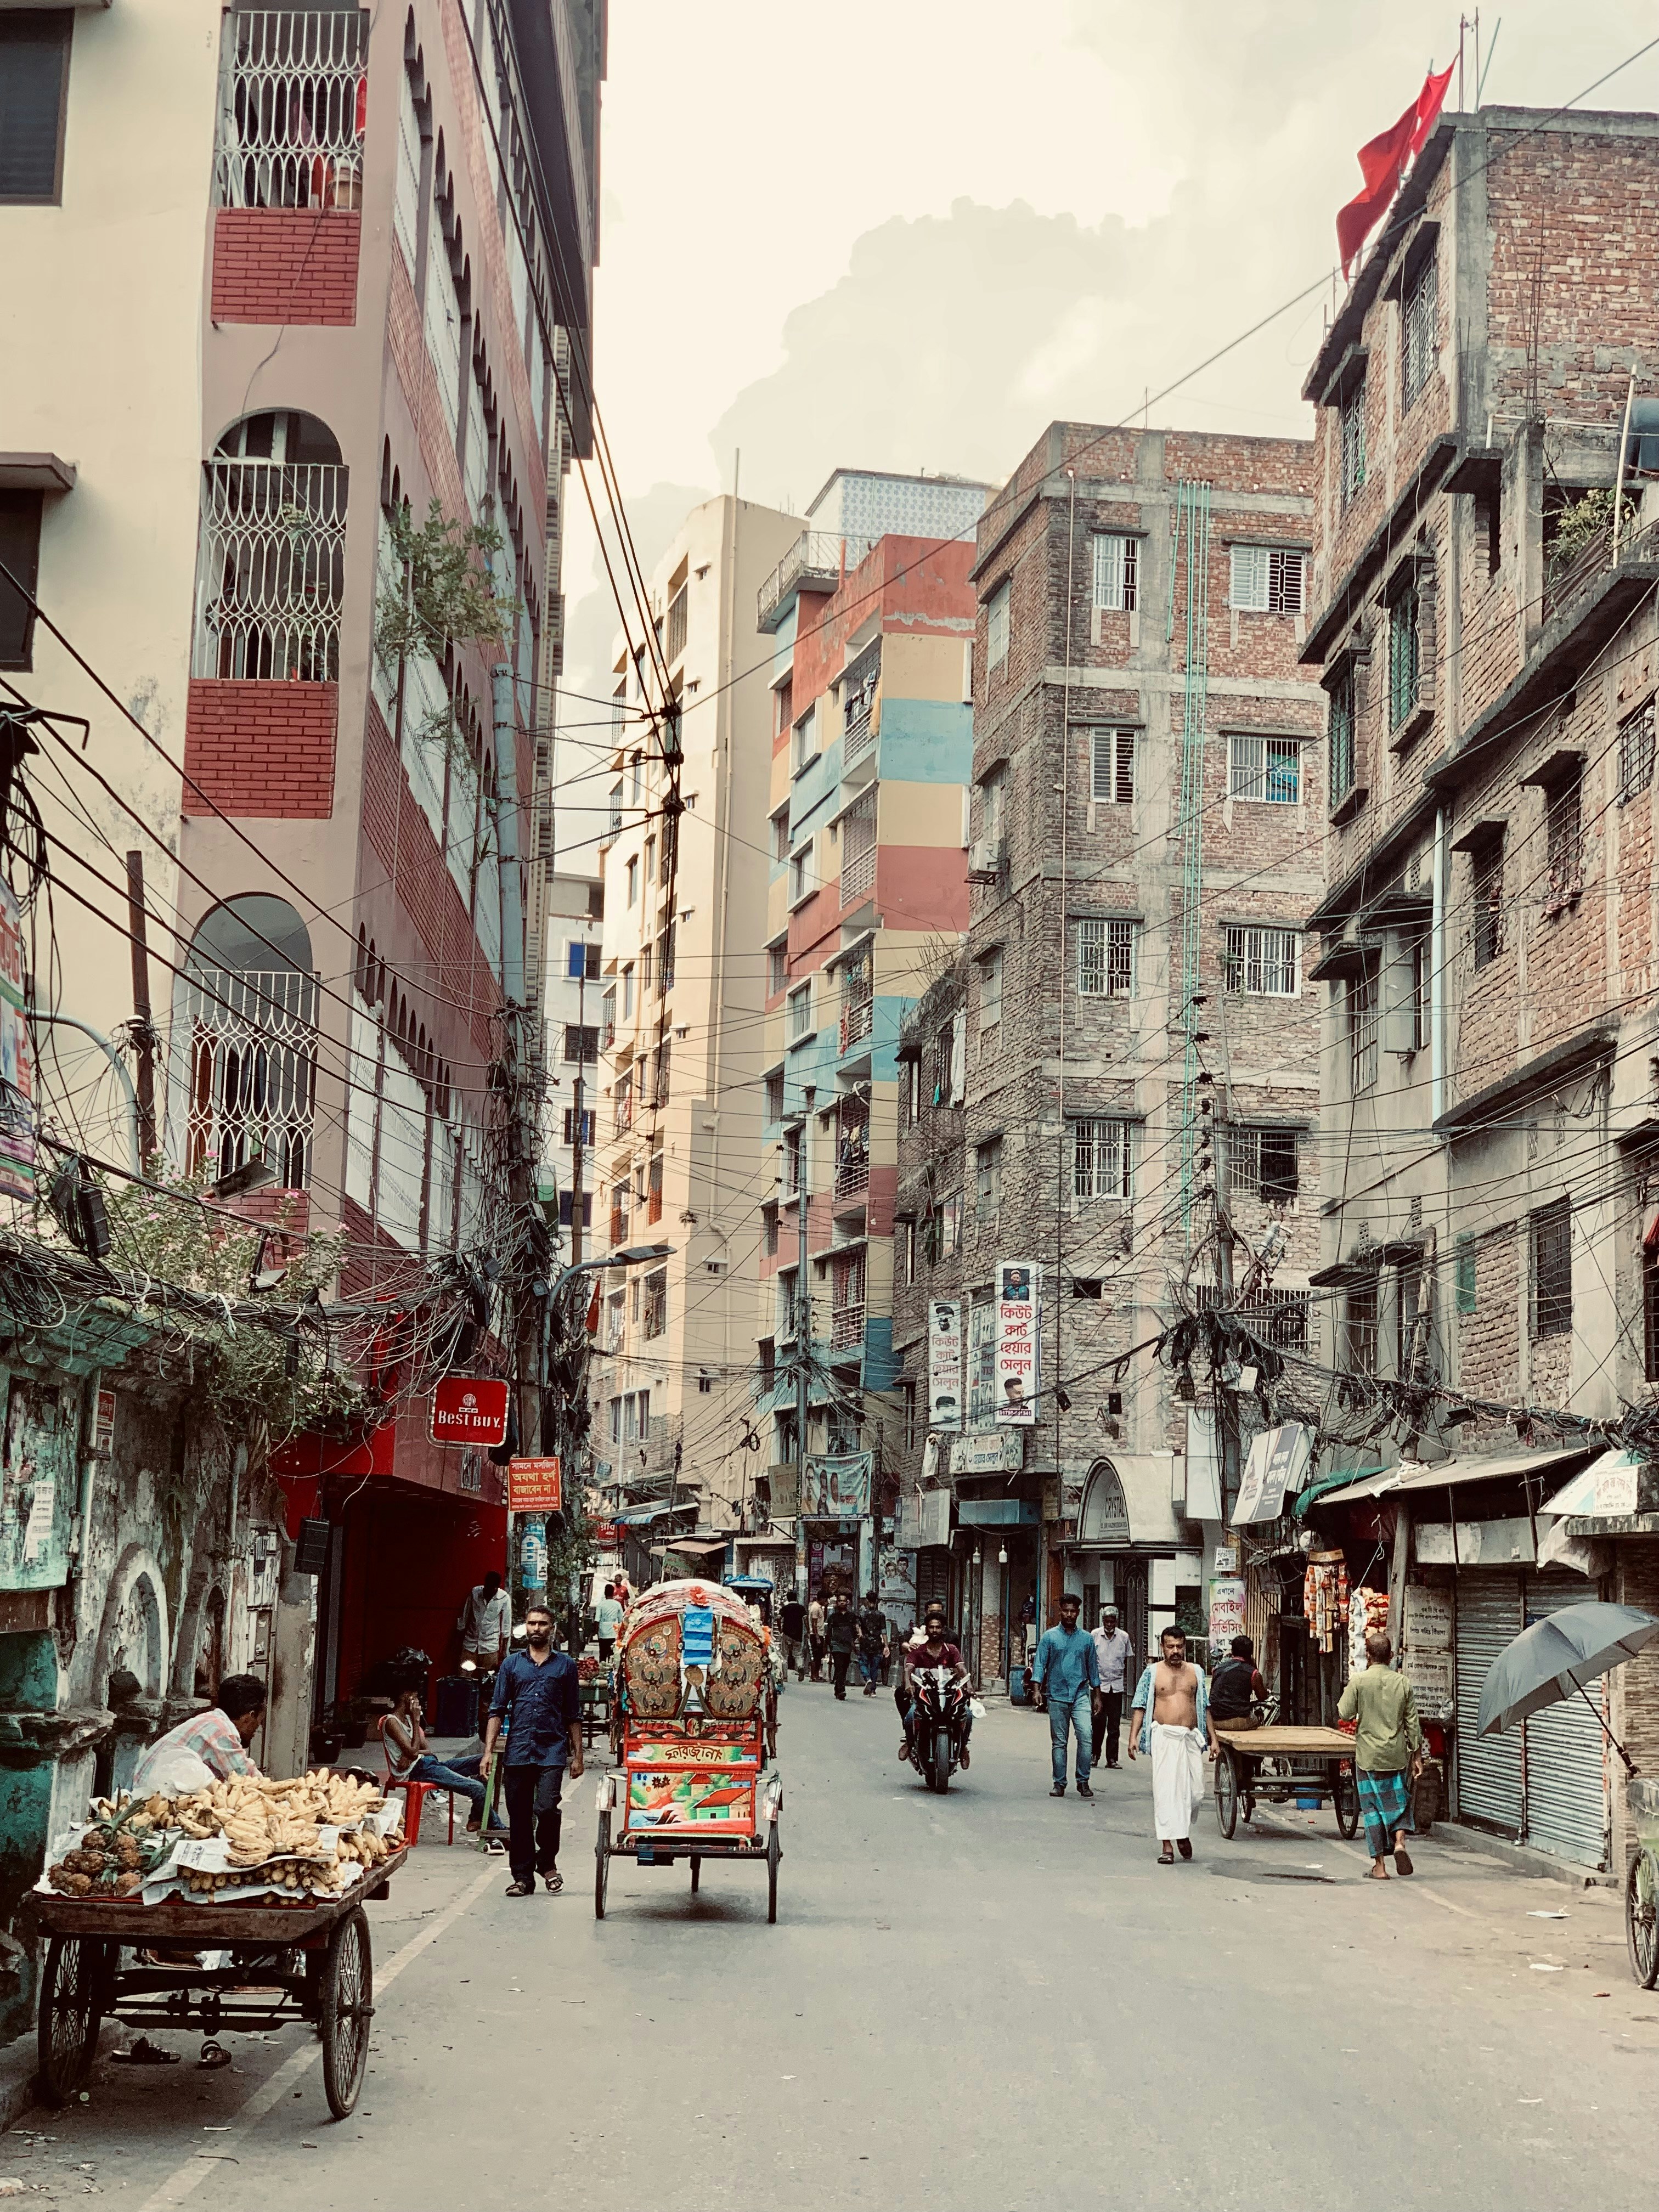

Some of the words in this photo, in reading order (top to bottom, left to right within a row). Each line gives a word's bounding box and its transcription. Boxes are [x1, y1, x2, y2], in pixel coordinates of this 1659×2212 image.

[1000, 1304, 1032, 1318] কিউট
[1005, 1322, 1028, 1336] কাট
[932, 1334, 958, 1346] কিউট
[935, 1349, 955, 1361] কাট
[1001, 1342, 1031, 1355] হেয়ার
[1000, 1359, 1031, 1375] সেলুন
[933, 1378, 958, 1390] সেলুন
[438, 1410, 469, 1425] Best
[533, 1460, 556, 1469] মসজিদ
[512, 1472, 539, 1482] অযথা
[512, 1485, 542, 1494] বাজাবেন
[1105, 1496, 1125, 1519] CRYSTAL
[1212, 1599, 1243, 1614] মোবাইল
[1212, 1620, 1243, 1635] সার্ভিসিং
[665, 1746, 723, 1762] ফারজানা
